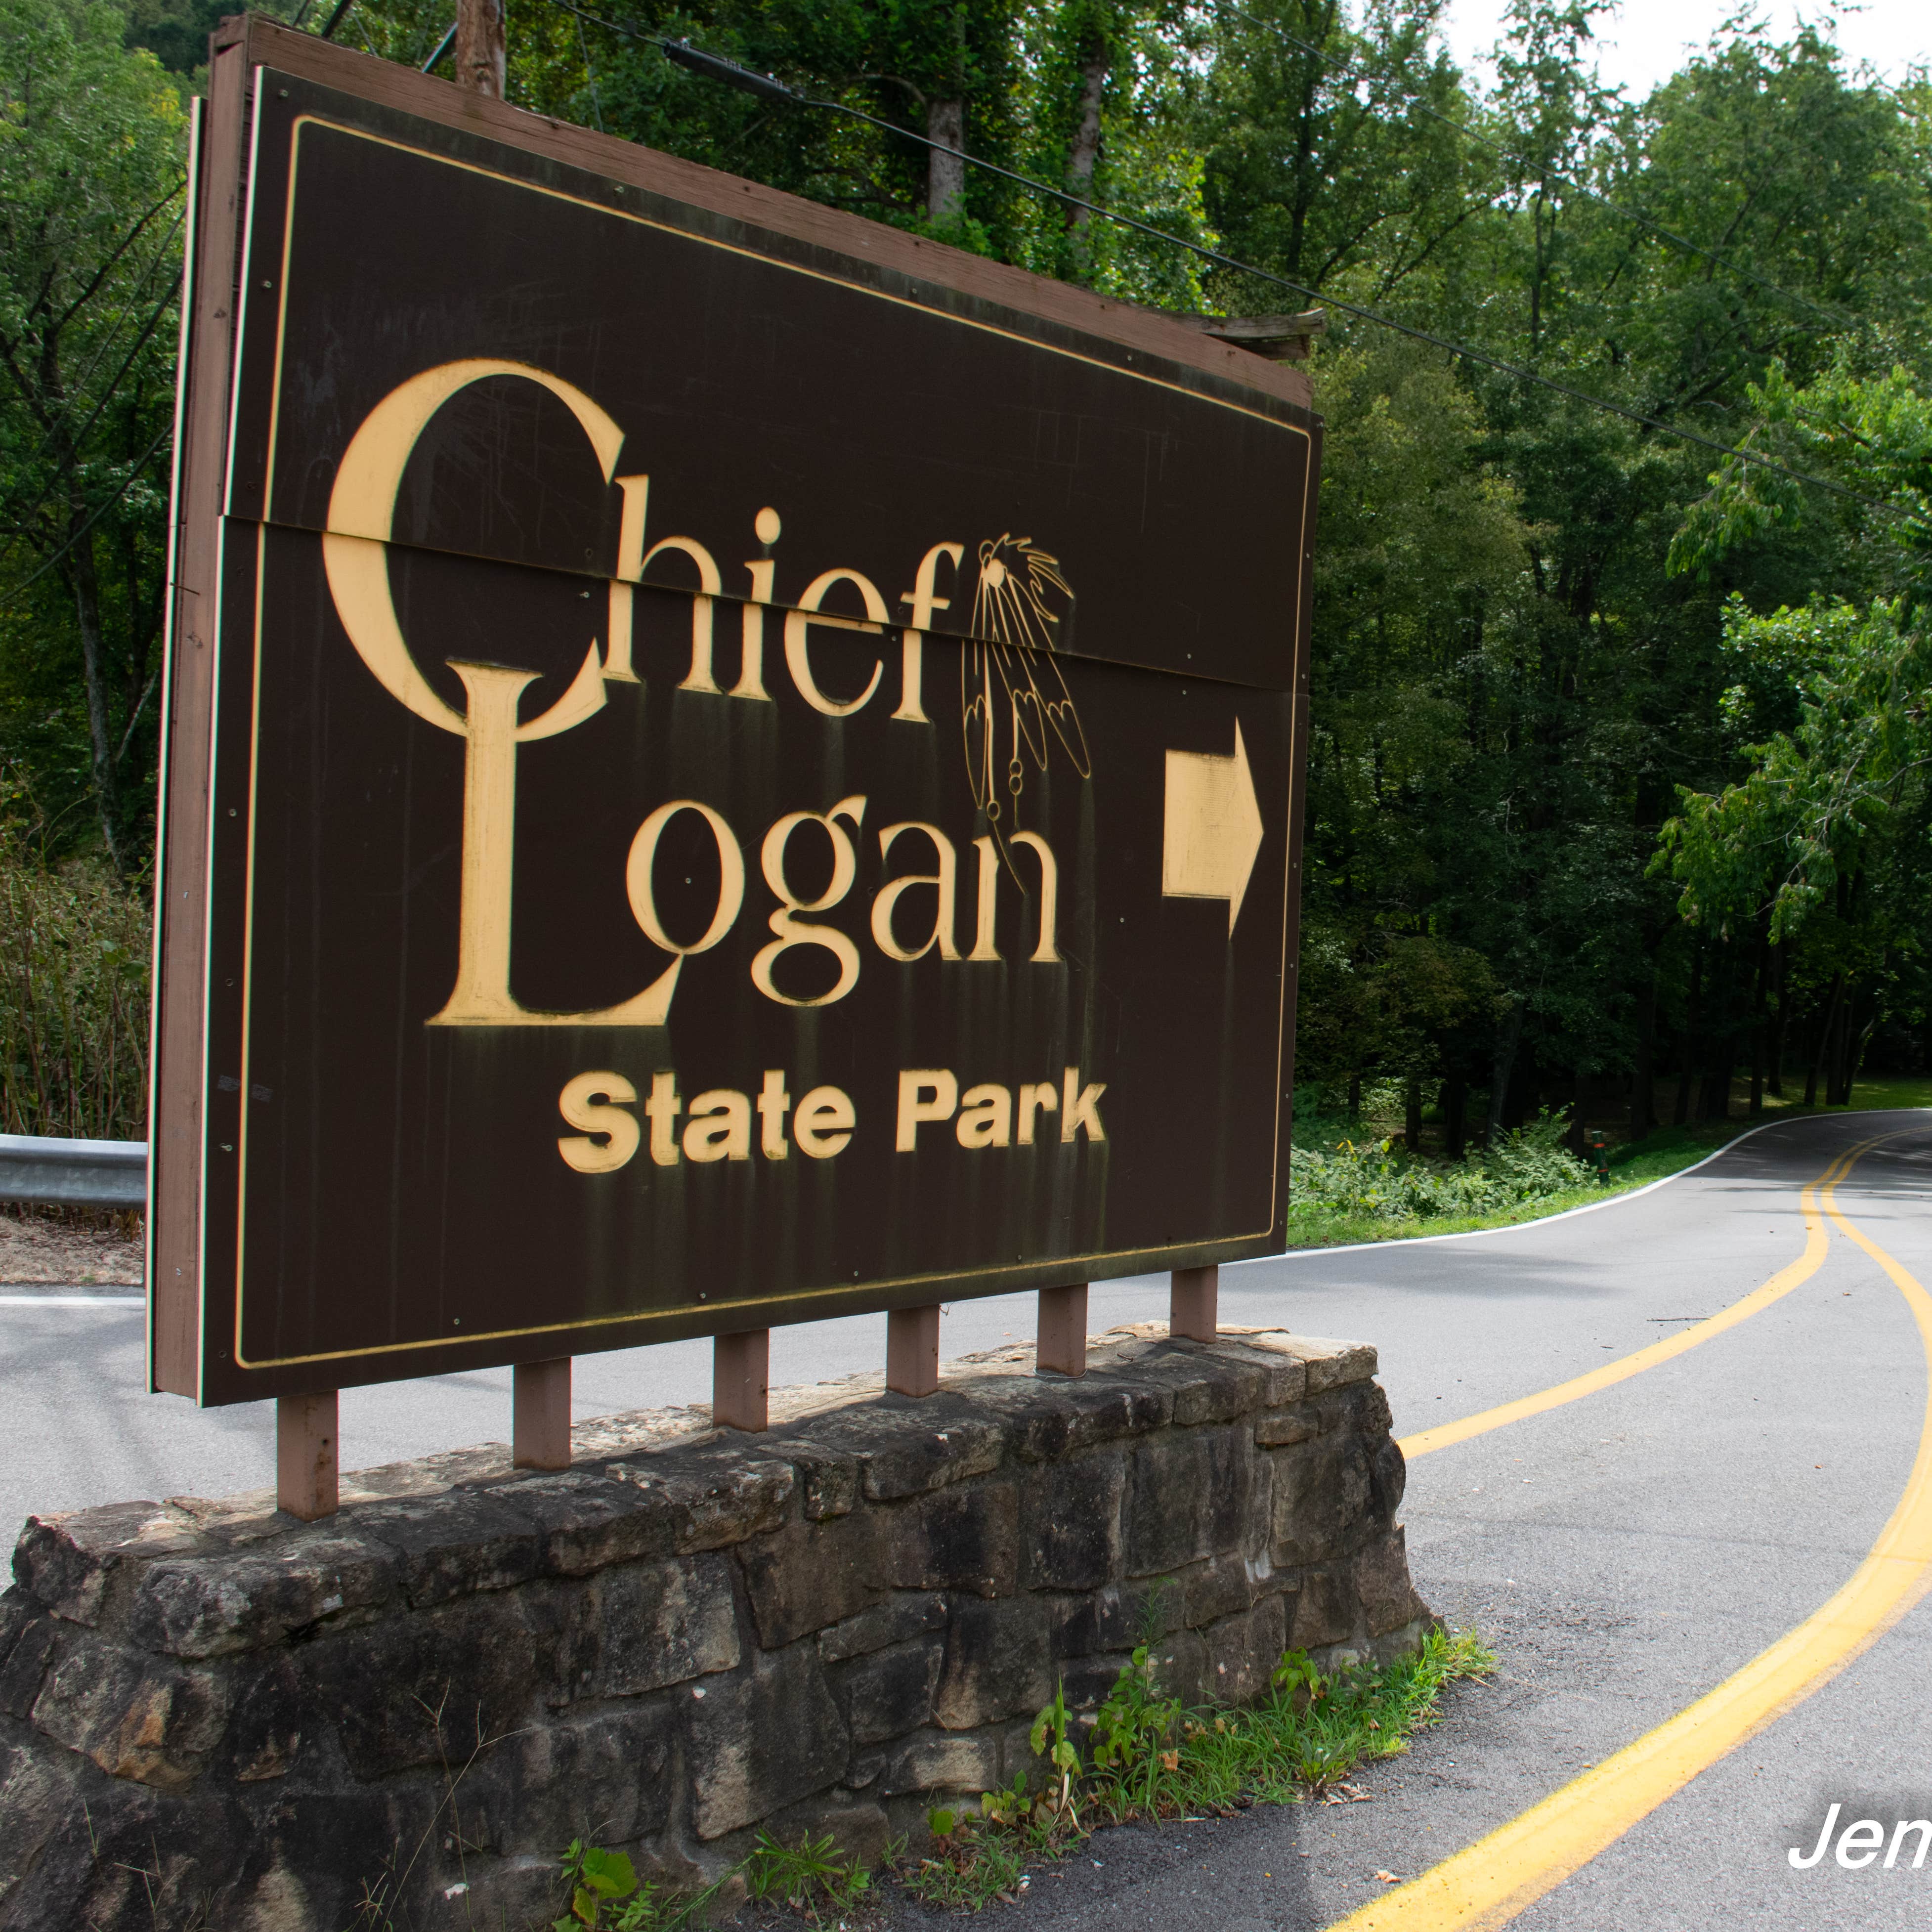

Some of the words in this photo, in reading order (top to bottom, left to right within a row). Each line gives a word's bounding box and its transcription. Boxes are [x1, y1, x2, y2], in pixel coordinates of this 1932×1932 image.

[322, 357, 964, 742] Chief
[425, 659, 1062, 1026] Logan
[558, 1070, 857, 1174] State
[895, 1066, 1108, 1155] Park
